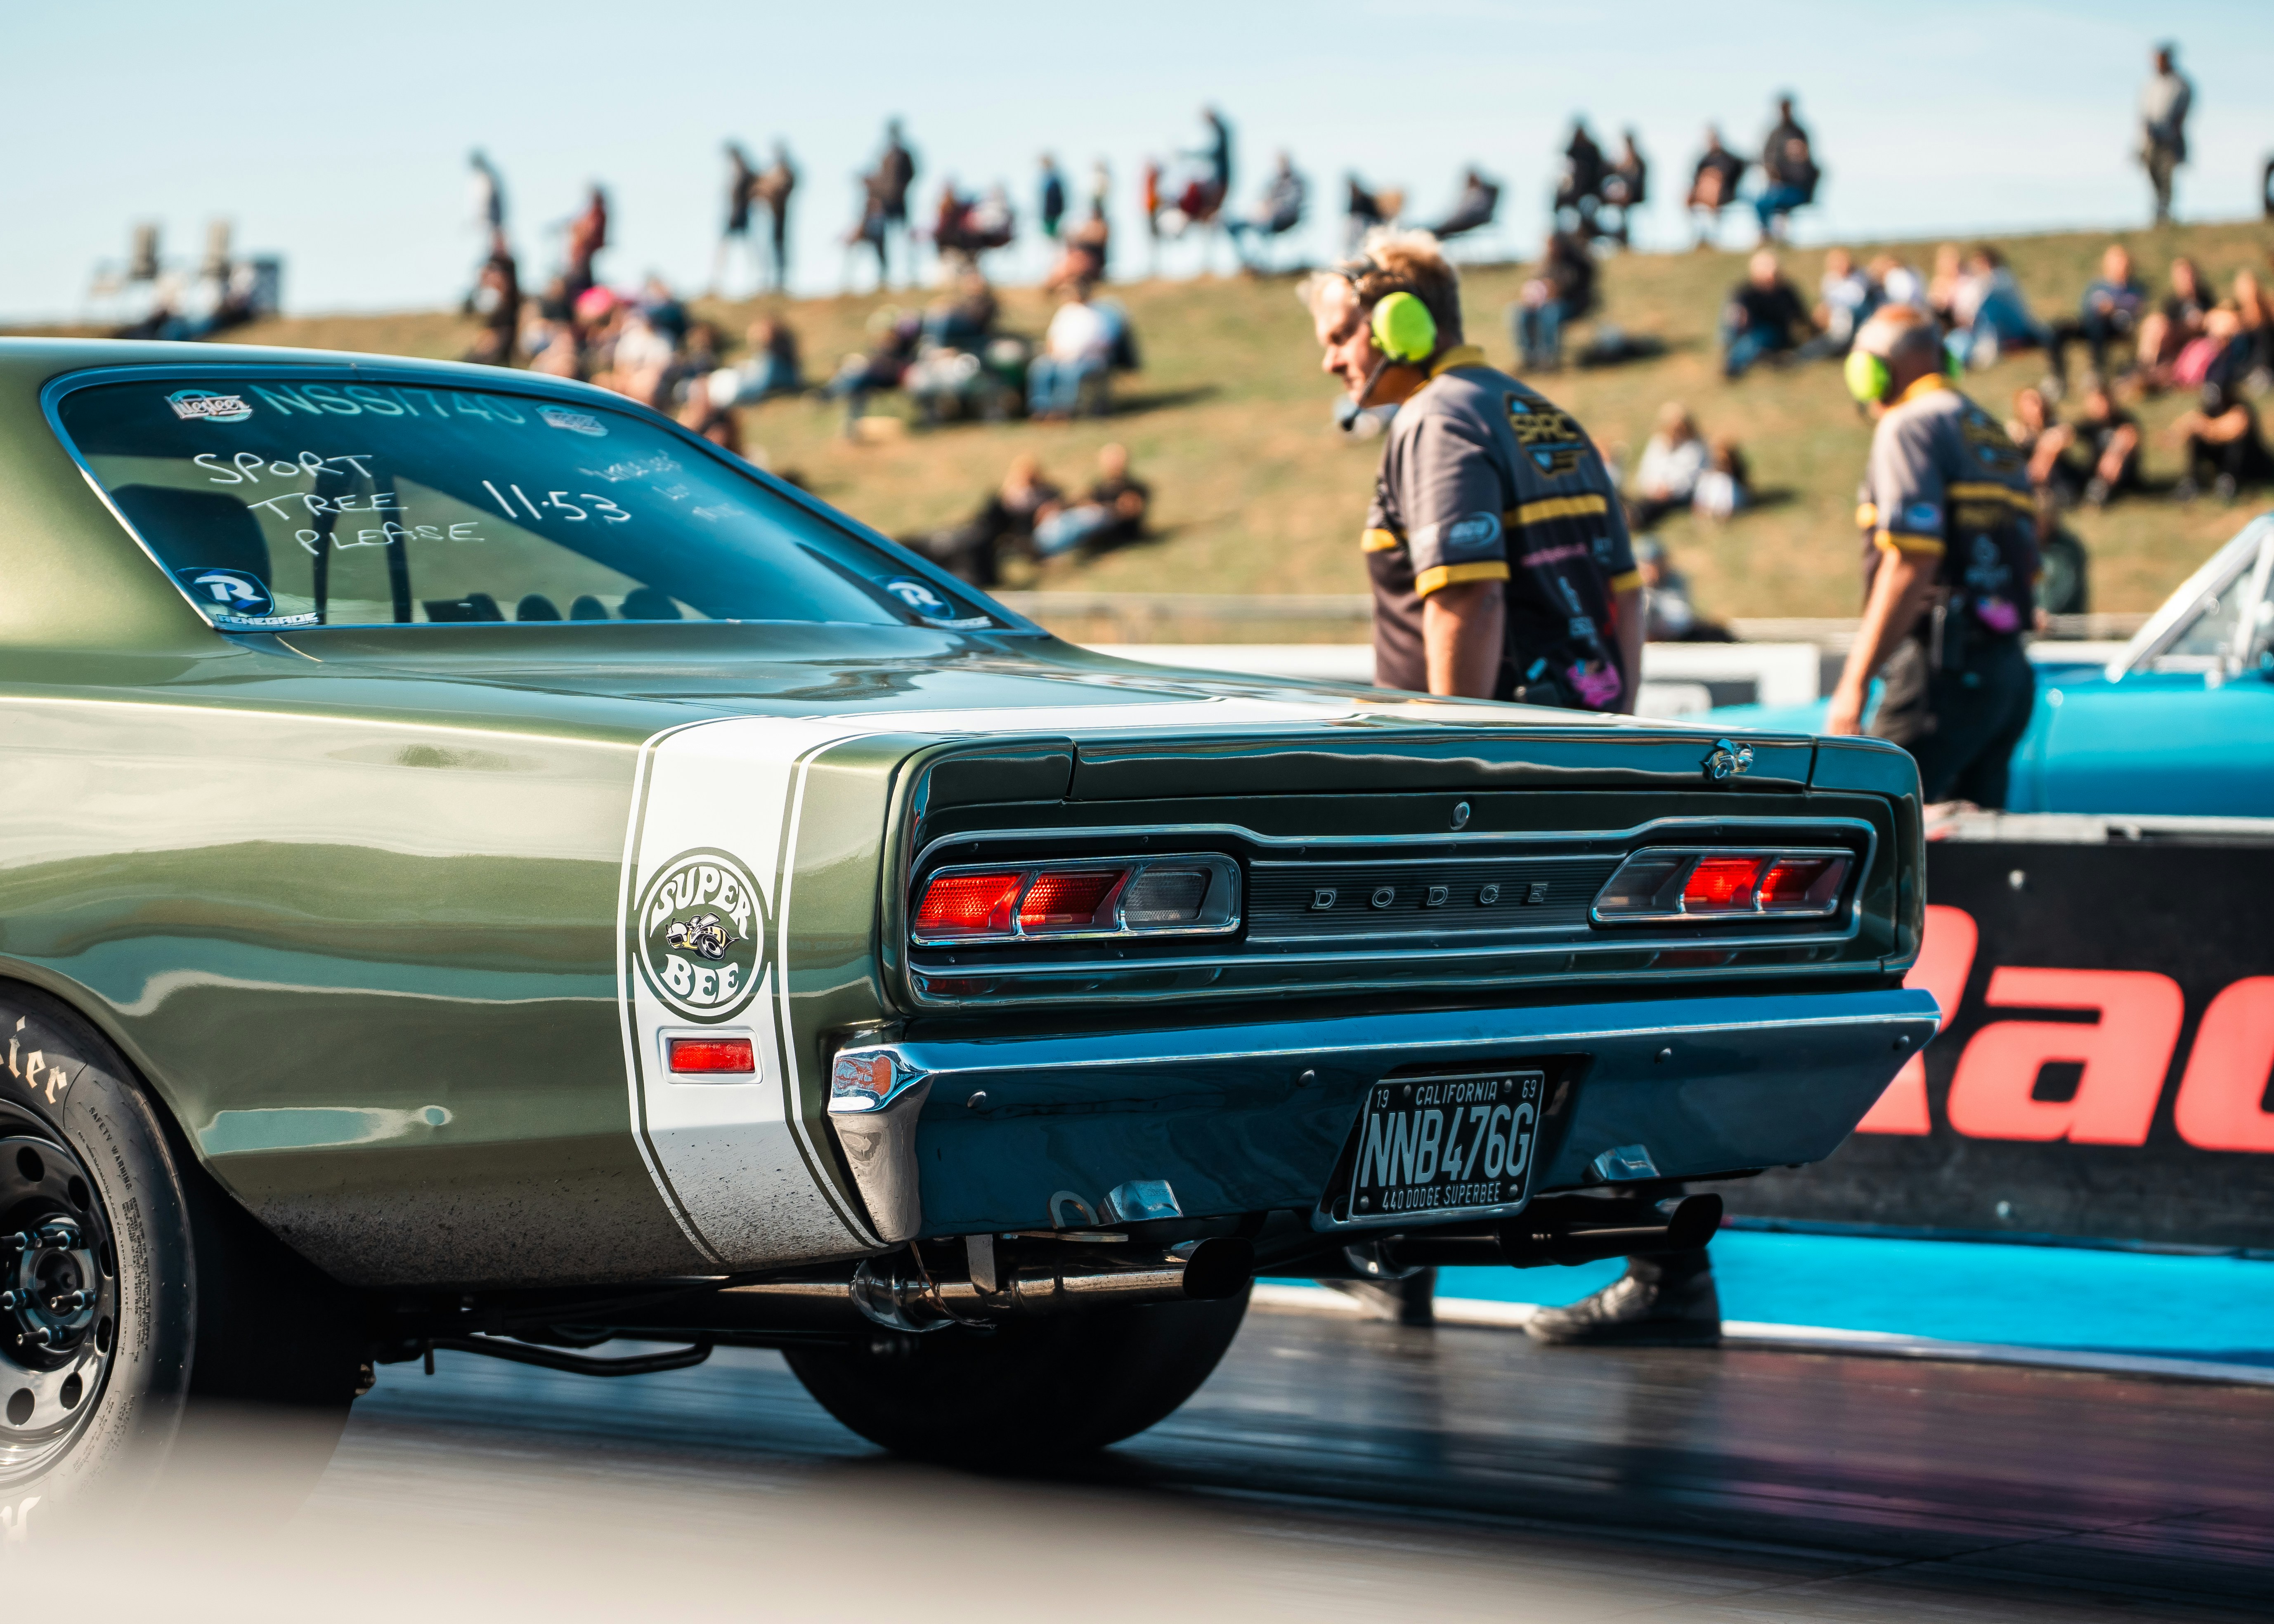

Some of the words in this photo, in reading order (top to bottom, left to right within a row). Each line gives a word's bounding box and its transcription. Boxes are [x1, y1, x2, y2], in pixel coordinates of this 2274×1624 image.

[193, 451, 372, 484] SPORT
[248, 492, 408, 520] TREE
[295, 521, 485, 555] PLEASE
[217, 612, 319, 626] RENEGADE
[649, 866, 751, 940] SUPER
[1311, 883, 1548, 909] DODGE
[660, 954, 738, 1004] BEE
[0, 1015, 67, 1104] ier
[1376, 1089, 1390, 1108] 19
[1415, 1081, 1498, 1105] CALIFORNIA
[1522, 1079, 1537, 1099] 69
[89, 1106, 112, 1141] SAFETY
[1360, 1102, 1534, 1188] NNB476G
[1382, 1190, 1404, 1210] 440
[1406, 1186, 1440, 1209] DODGE
[1444, 1181, 1501, 1204] SUPERBEE
